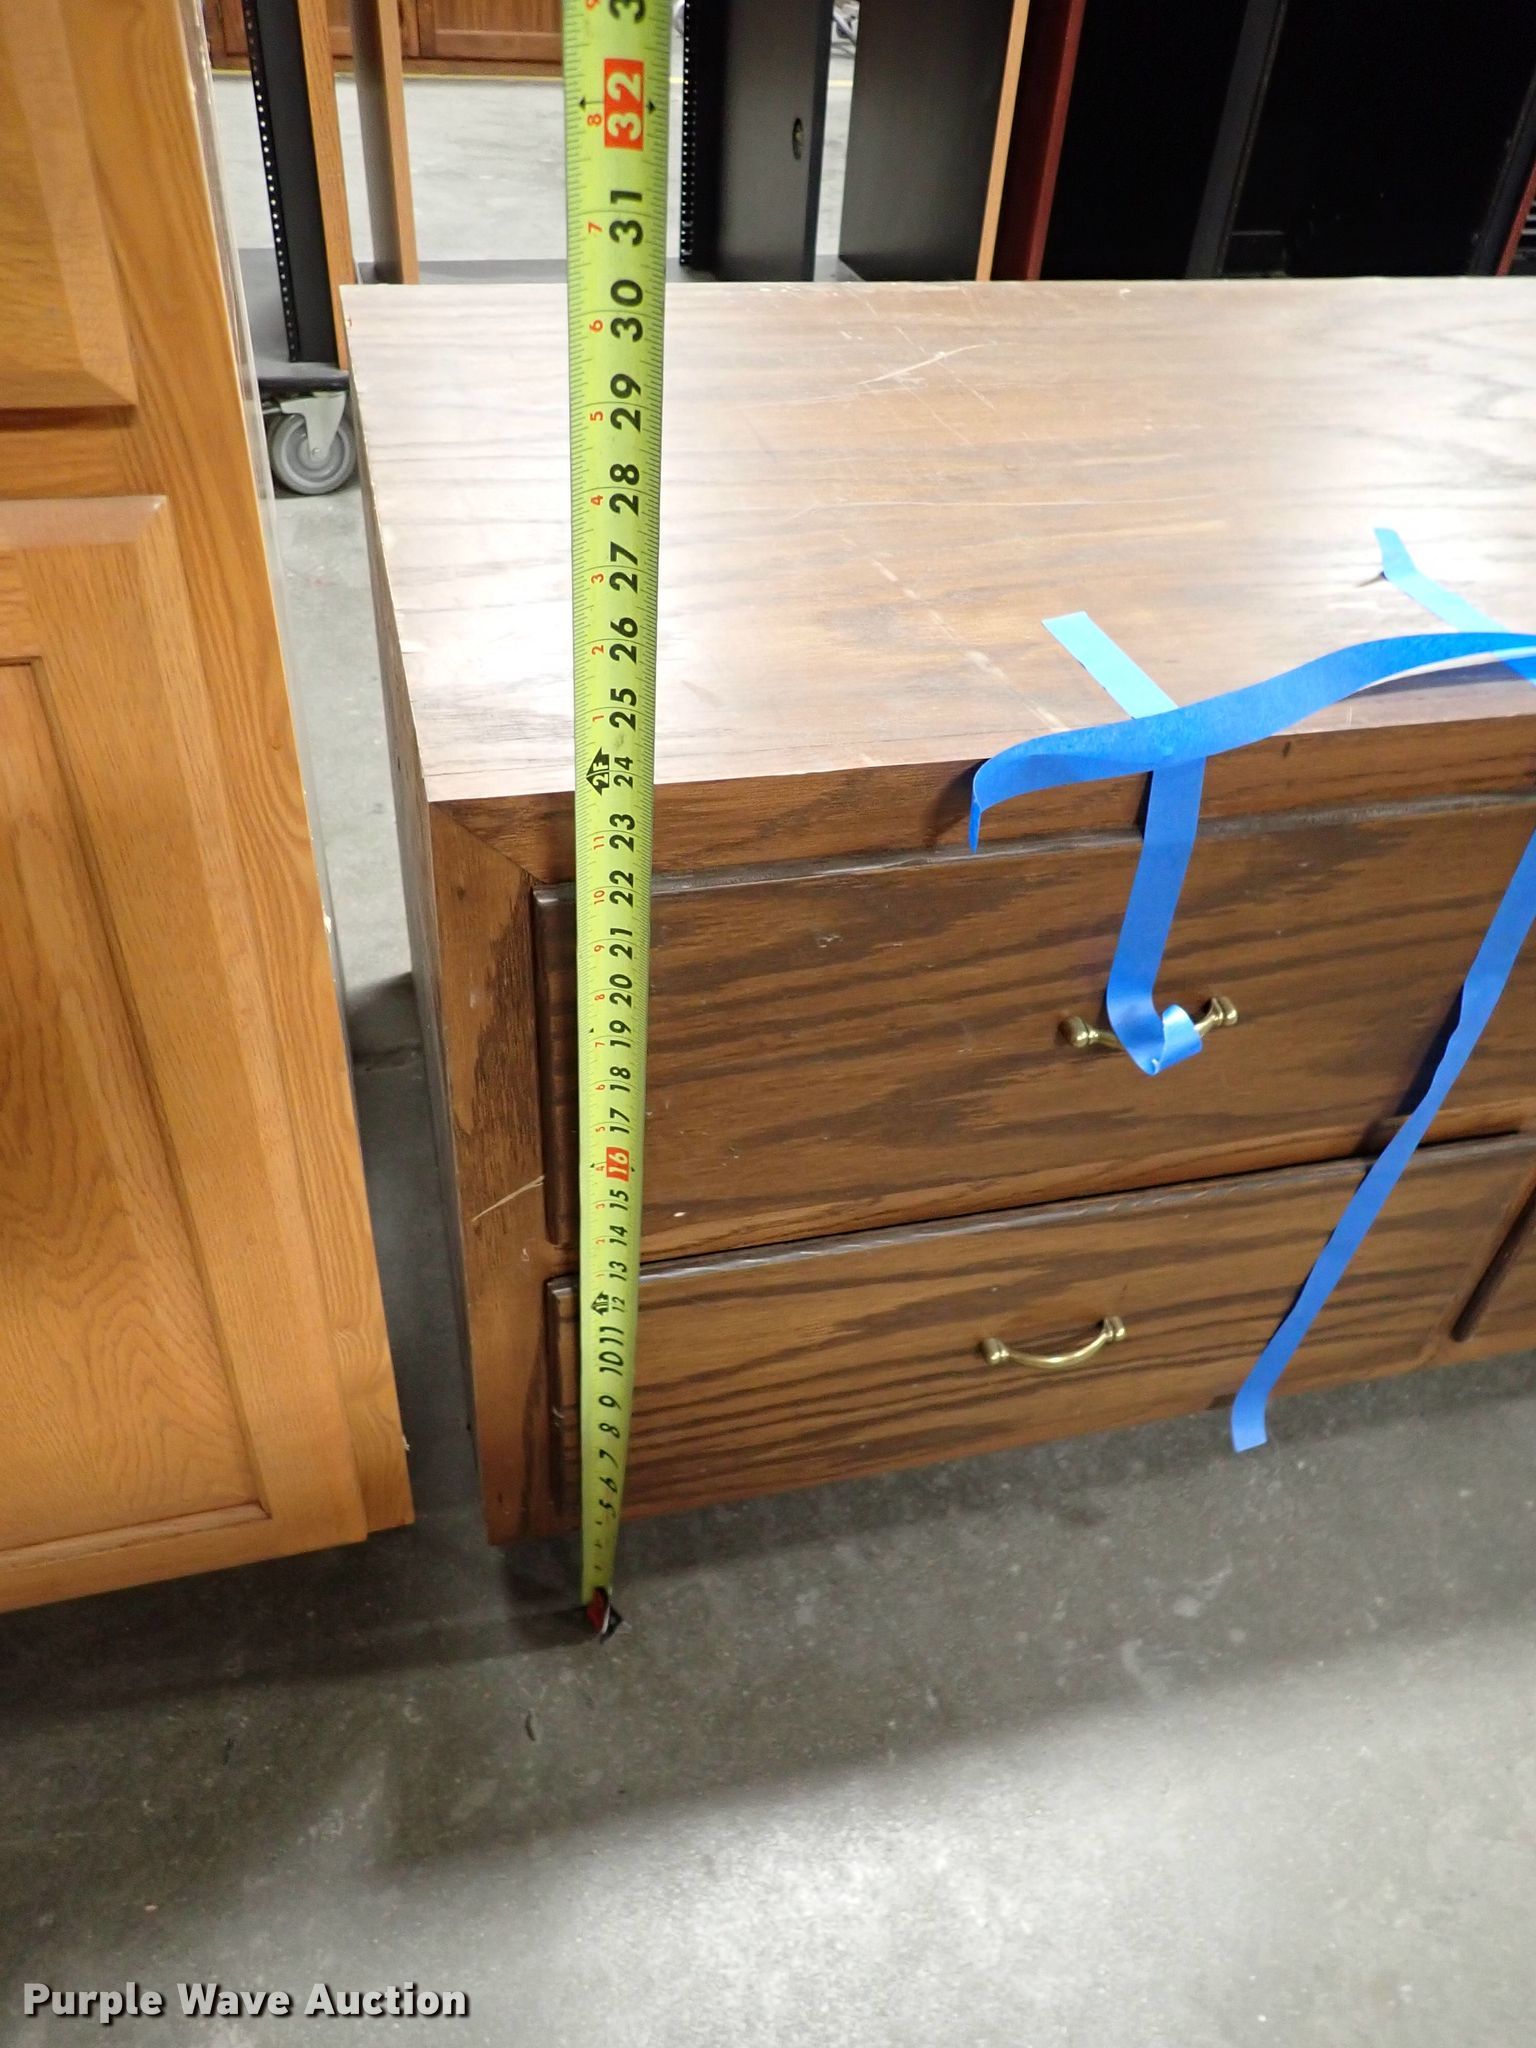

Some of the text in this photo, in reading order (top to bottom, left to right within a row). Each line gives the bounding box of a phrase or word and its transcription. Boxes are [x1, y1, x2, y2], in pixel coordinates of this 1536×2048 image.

[607, 72, 641, 140] 32
[587, 113, 602, 126] 8
[588, 222, 602, 233] 7
[609, 190, 643, 246] 31
[610, 279, 643, 342] 30
[589, 319, 603, 332] 6
[610, 373, 641, 432] 29
[590, 411, 603, 421] 5
[591, 495, 603, 505] 4
[609, 463, 639, 516] 28
[591, 573, 604, 583] 3
[609, 541, 638, 594] 27
[591, 645, 604, 655] 2
[609, 617, 638, 664] 26
[609, 688, 637, 731] 25
[613, 756, 633, 789] 24
[593, 836, 604, 850] 11
[609, 814, 635, 852] 23
[594, 890, 605, 904] 10
[609, 870, 633, 908] 22
[594, 944, 605, 953] 9
[609, 928, 633, 960] 21
[594, 993, 605, 1001] 8
[609, 974, 633, 1008] 20
[609, 1020, 632, 1048] 19
[609, 1066, 631, 1092] 18
[609, 1107, 631, 1134] 17
[608, 1151, 628, 1174] 16
[609, 1189, 629, 1211] 15
[609, 1224, 628, 1246] 14
[609, 1260, 627, 1282] 13
[612, 1296, 626, 1313] 12
[599, 1326, 624, 1346] 11
[599, 1351, 624, 1376] 10
[599, 1395, 622, 1410] 9
[599, 1423, 620, 1439] 8
[599, 1448, 619, 1469] 7
